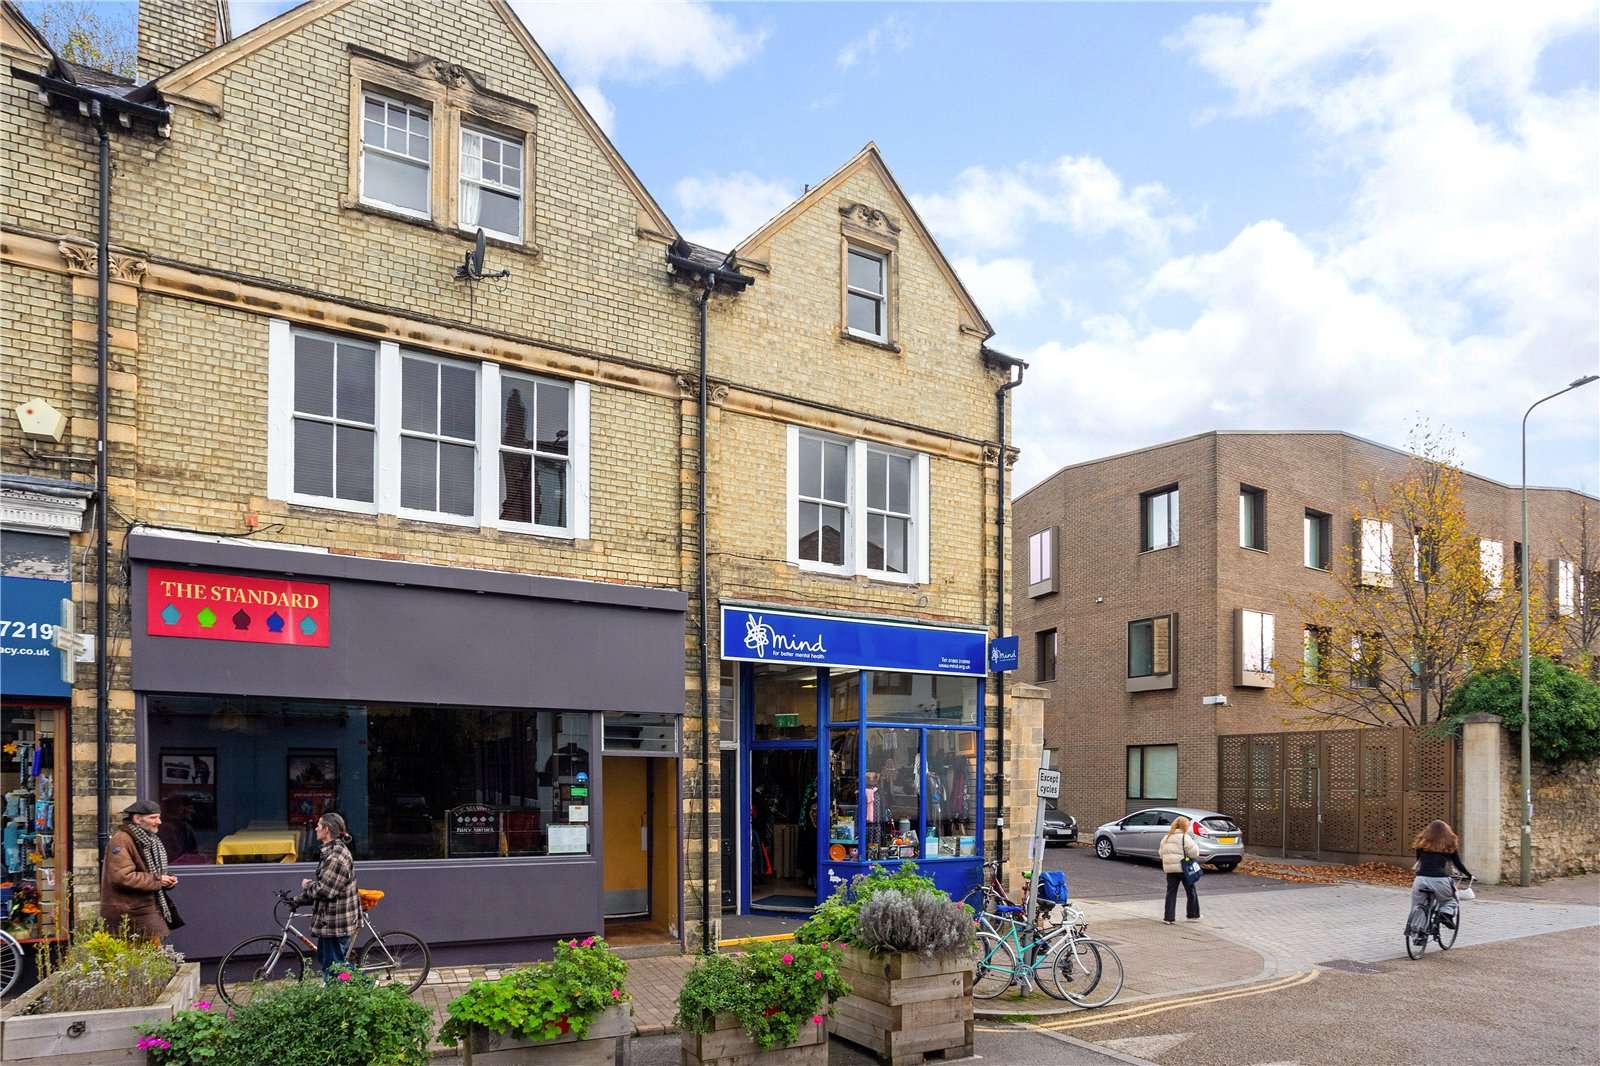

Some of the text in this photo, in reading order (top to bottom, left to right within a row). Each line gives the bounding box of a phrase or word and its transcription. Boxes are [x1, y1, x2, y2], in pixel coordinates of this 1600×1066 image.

[161, 580, 319, 609] THE STANDARD
[1040, 772, 1058, 783] Except
[1040, 785, 1057, 794] cycles
